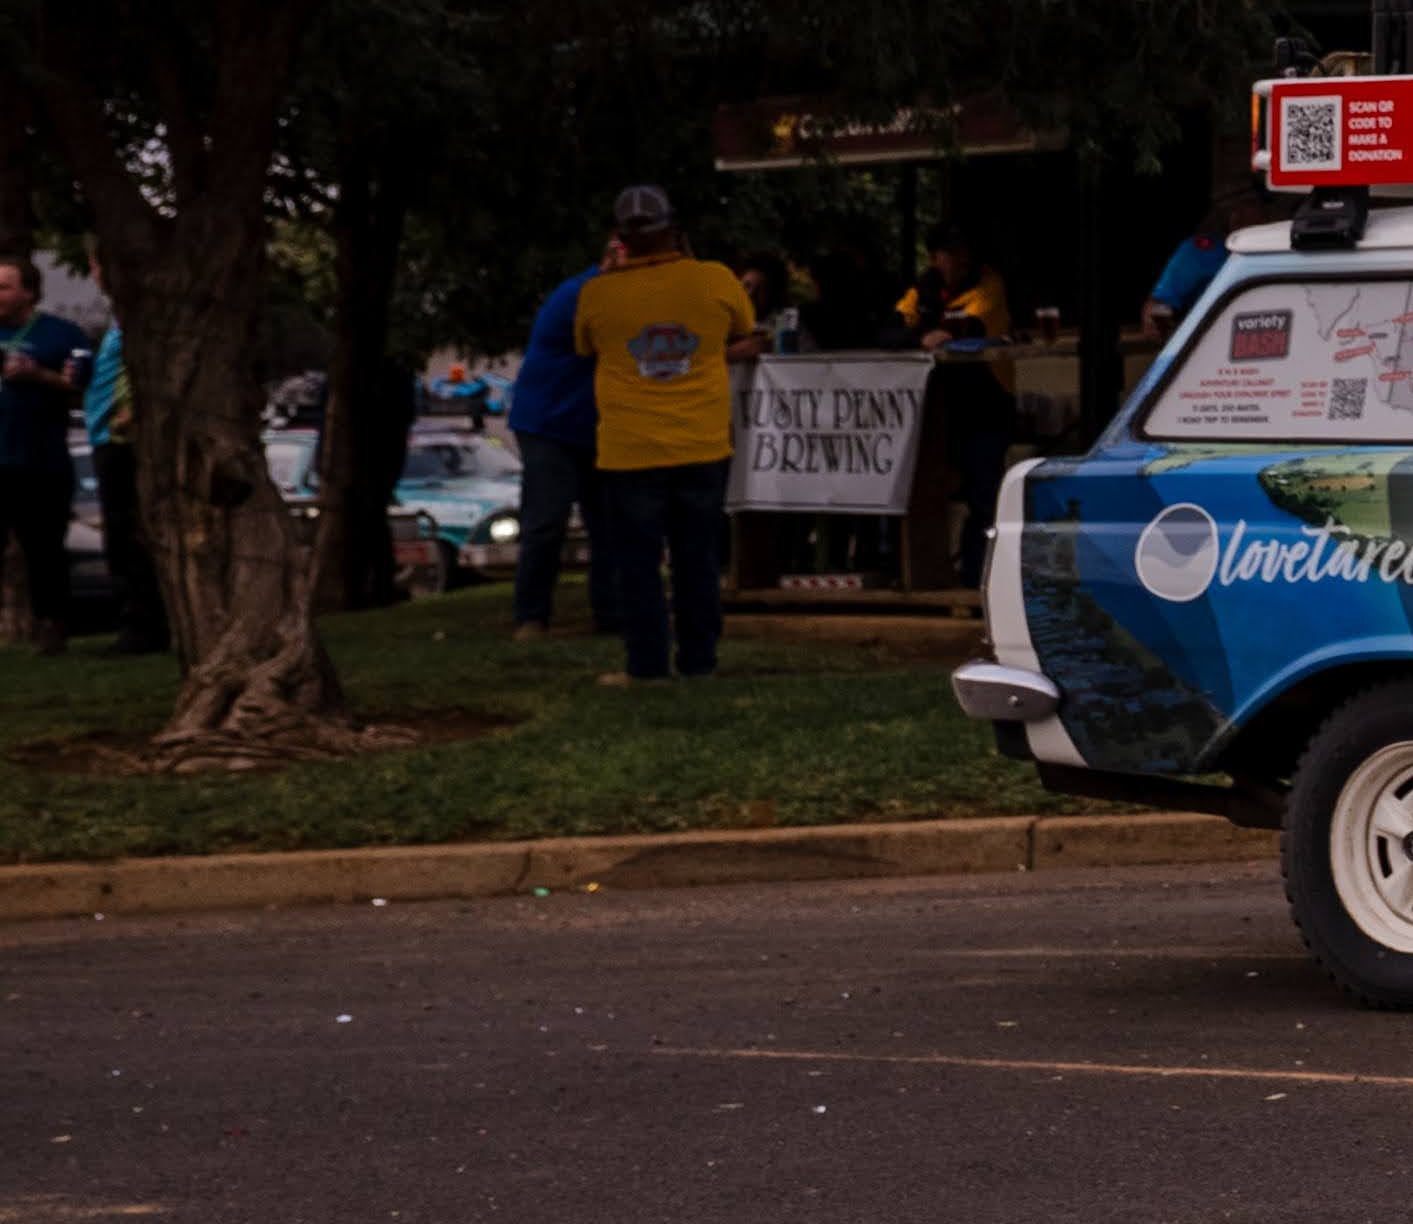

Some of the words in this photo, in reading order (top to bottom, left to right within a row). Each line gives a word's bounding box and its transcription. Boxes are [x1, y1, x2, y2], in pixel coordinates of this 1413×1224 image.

[1348, 101, 1377, 113] SCAN
[1348, 117, 1376, 129] CODE
[1378, 116, 1392, 128] TO
[1348, 134, 1377, 145] MAKE
[1379, 133, 1388, 144] A
[1348, 149, 1403, 162] DONATION
[1236, 316, 1288, 331] variety
[832, 389, 922, 429] PENNY
[752, 432, 893, 474] BREWING
